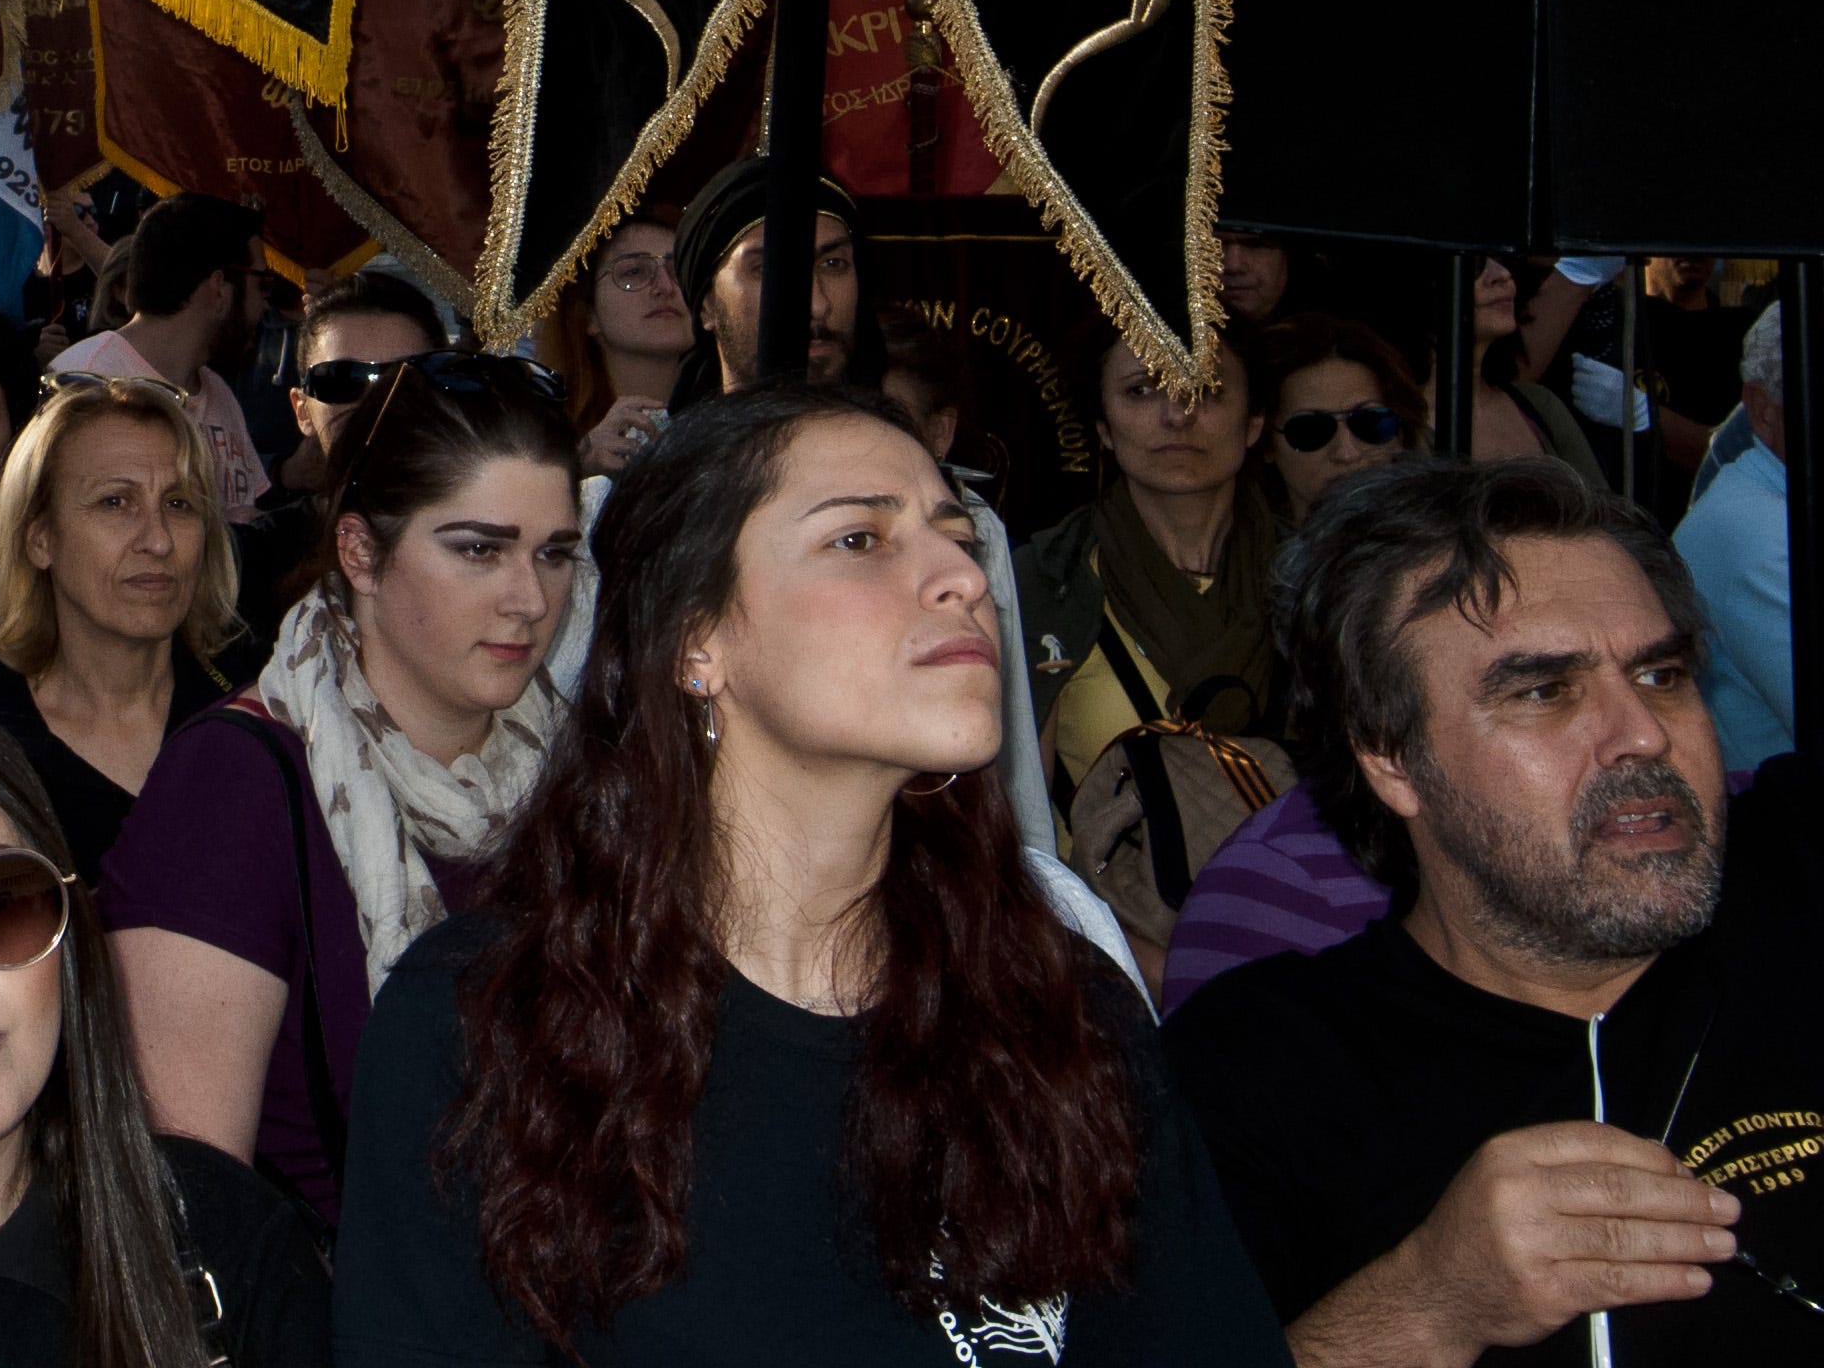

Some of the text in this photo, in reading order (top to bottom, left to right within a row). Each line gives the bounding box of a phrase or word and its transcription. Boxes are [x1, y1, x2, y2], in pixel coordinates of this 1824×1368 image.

[225, 157, 273, 174] ΕΤΟΣ
[1683, 1111, 1824, 1169] ΝΩΣΗ ΠΟΝΤΙΩ
